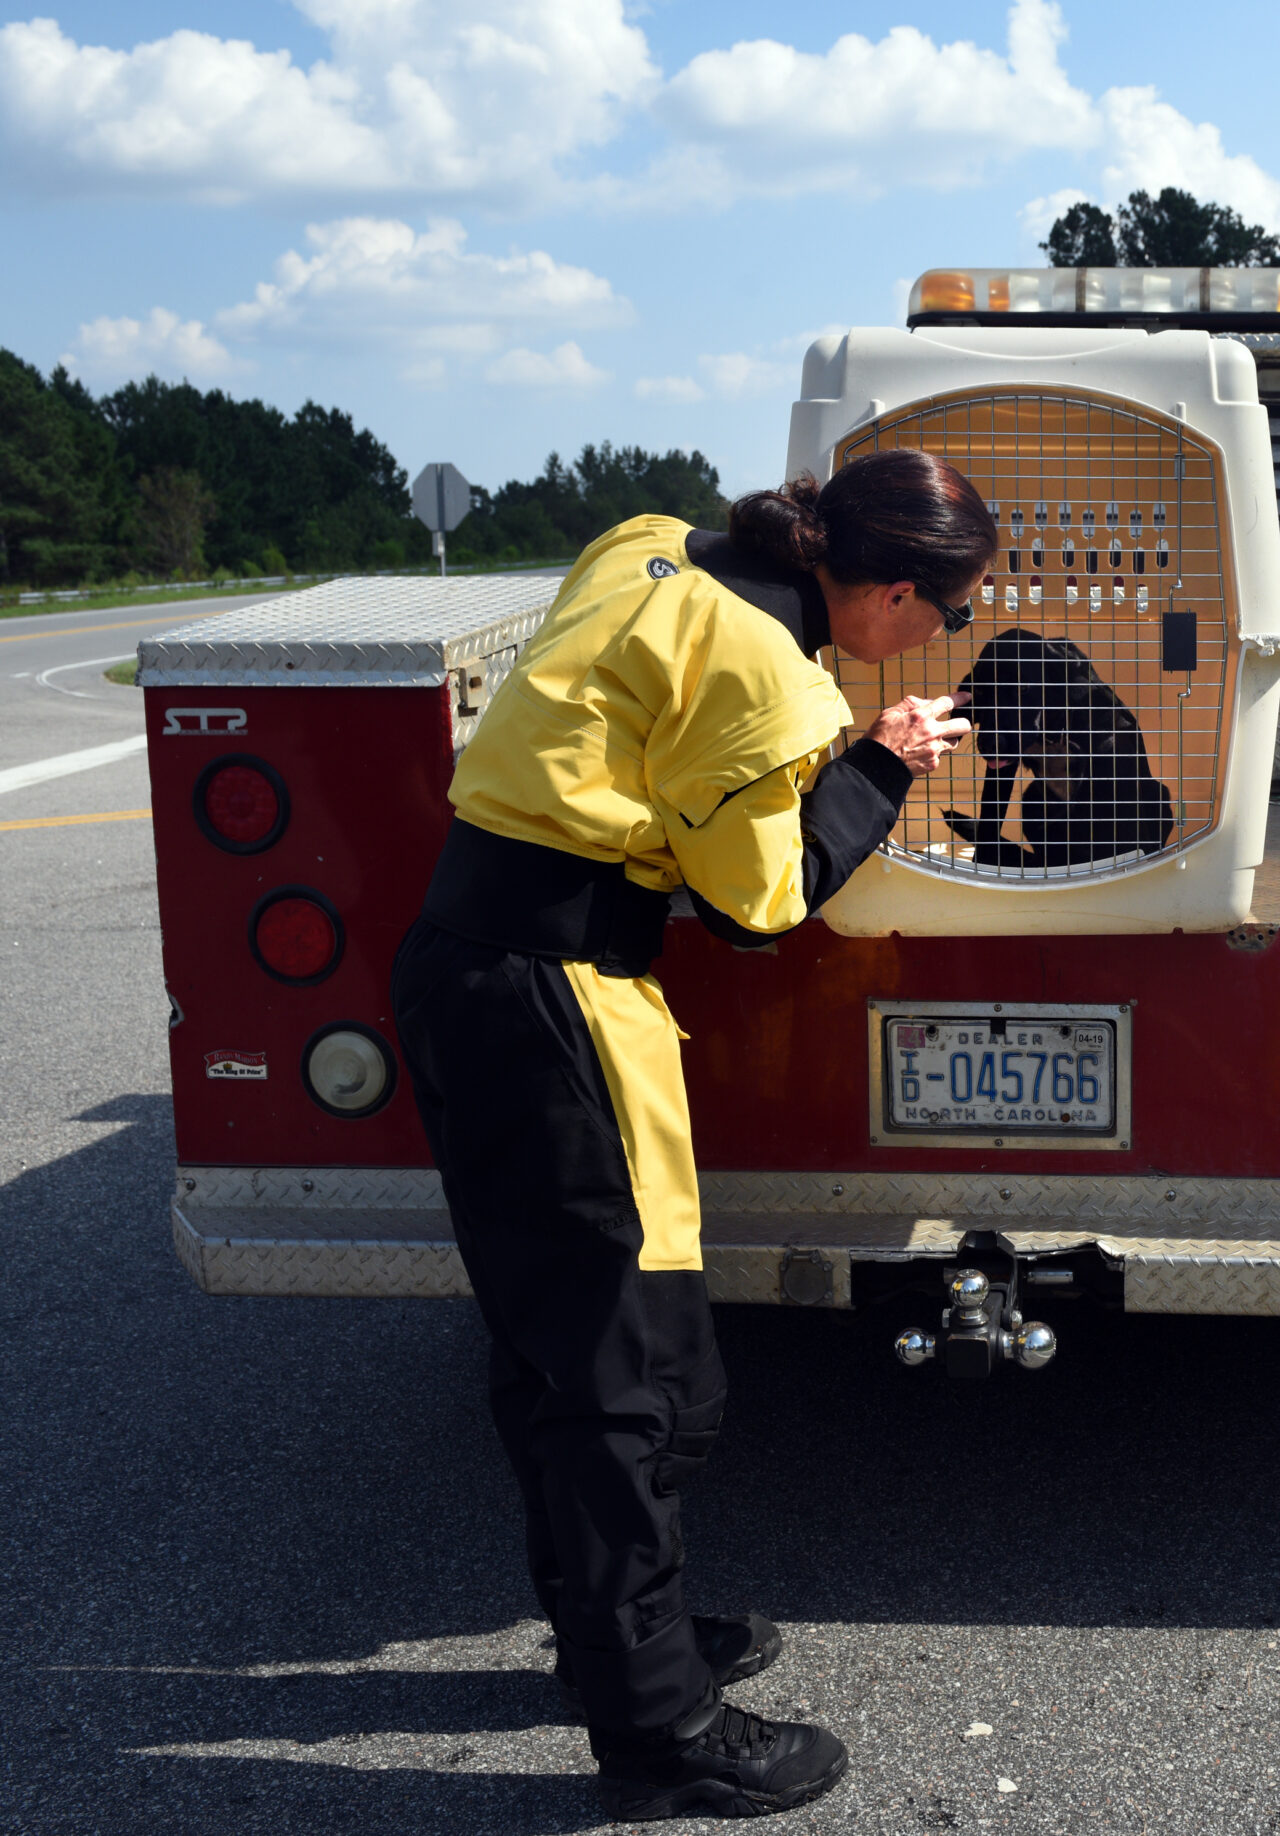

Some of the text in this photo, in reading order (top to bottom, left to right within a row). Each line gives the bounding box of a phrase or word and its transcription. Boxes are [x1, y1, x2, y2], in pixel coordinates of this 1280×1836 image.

[958, 1032, 1043, 1045] DEALER
[1078, 1034, 1103, 1044] 04-19
[906, 1107, 976, 1121] NORTH
